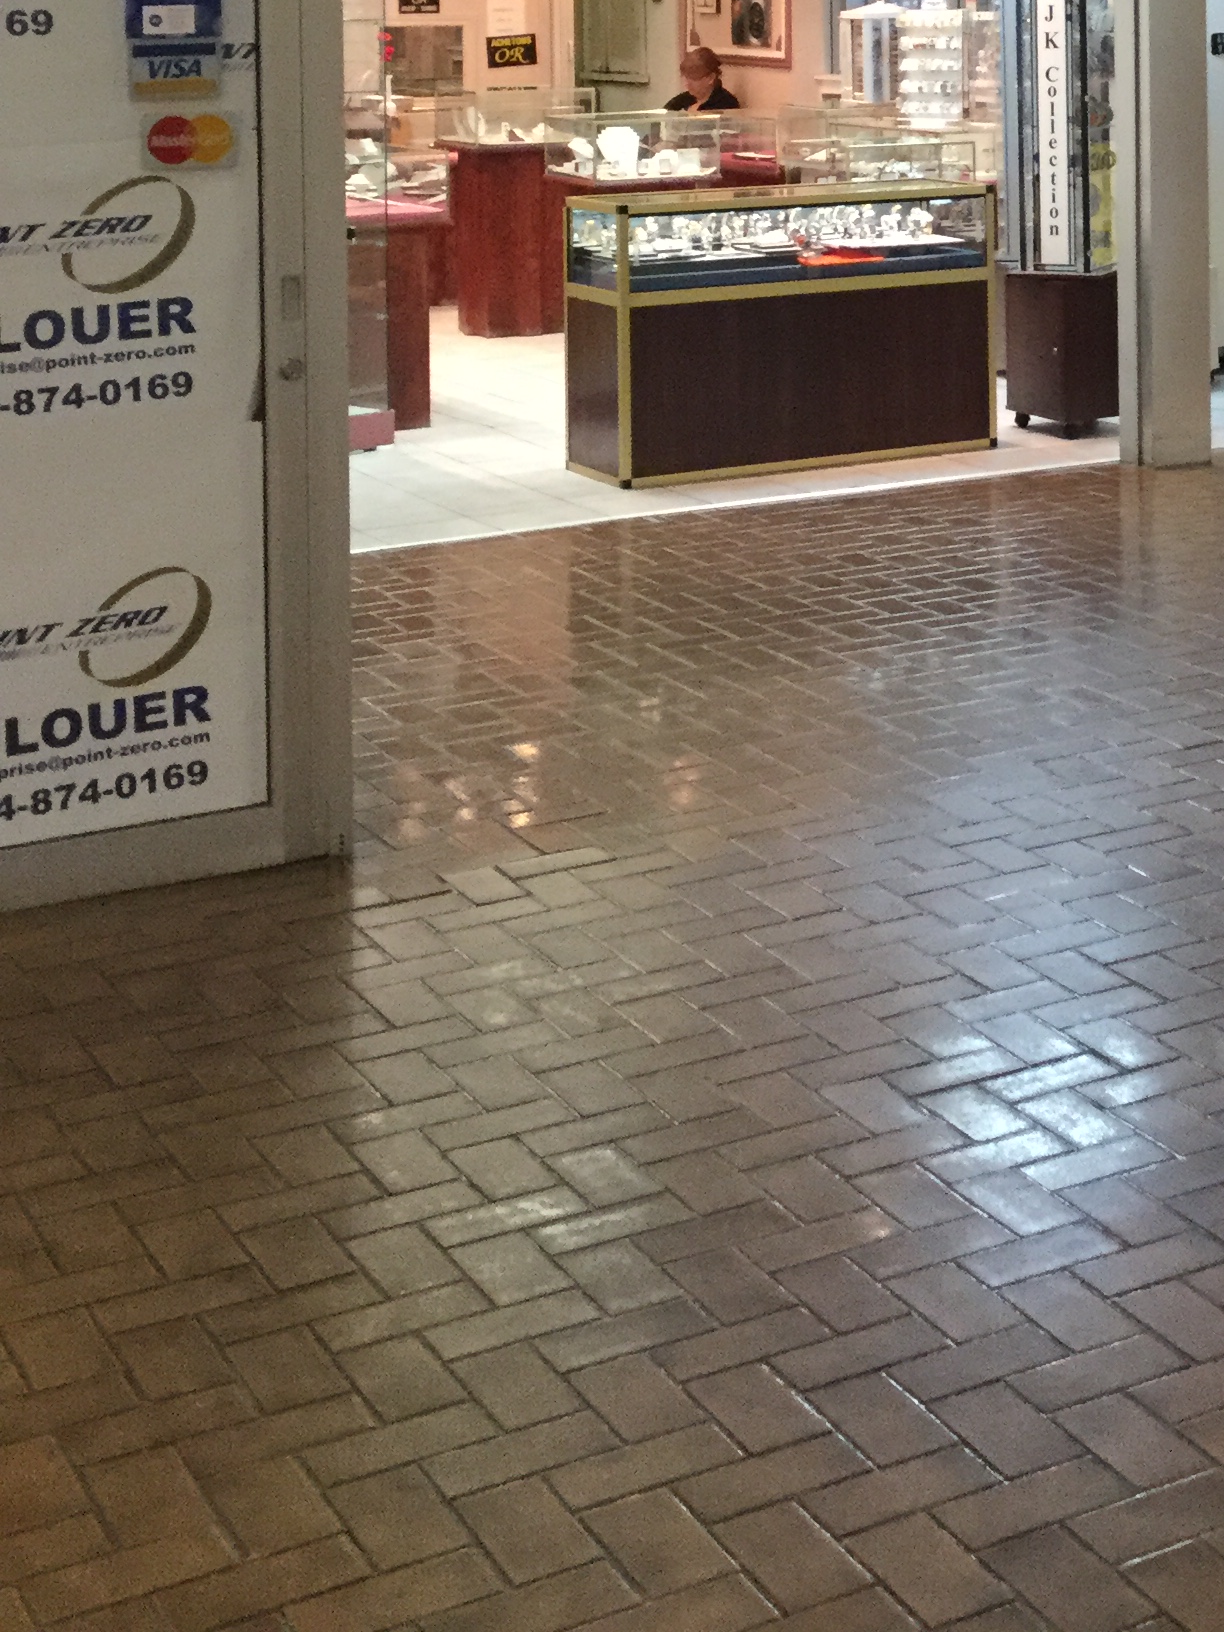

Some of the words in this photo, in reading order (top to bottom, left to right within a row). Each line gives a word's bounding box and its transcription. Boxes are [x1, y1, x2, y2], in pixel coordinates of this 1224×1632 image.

[149, 59, 202, 79] VISA
[495, 47, 529, 64] OR
[1045, 66, 1060, 236] Collection
[49, 215, 153, 240] ZERO
[66, 606, 168, 638] ZERO
[5, 686, 211, 757] LOUER
